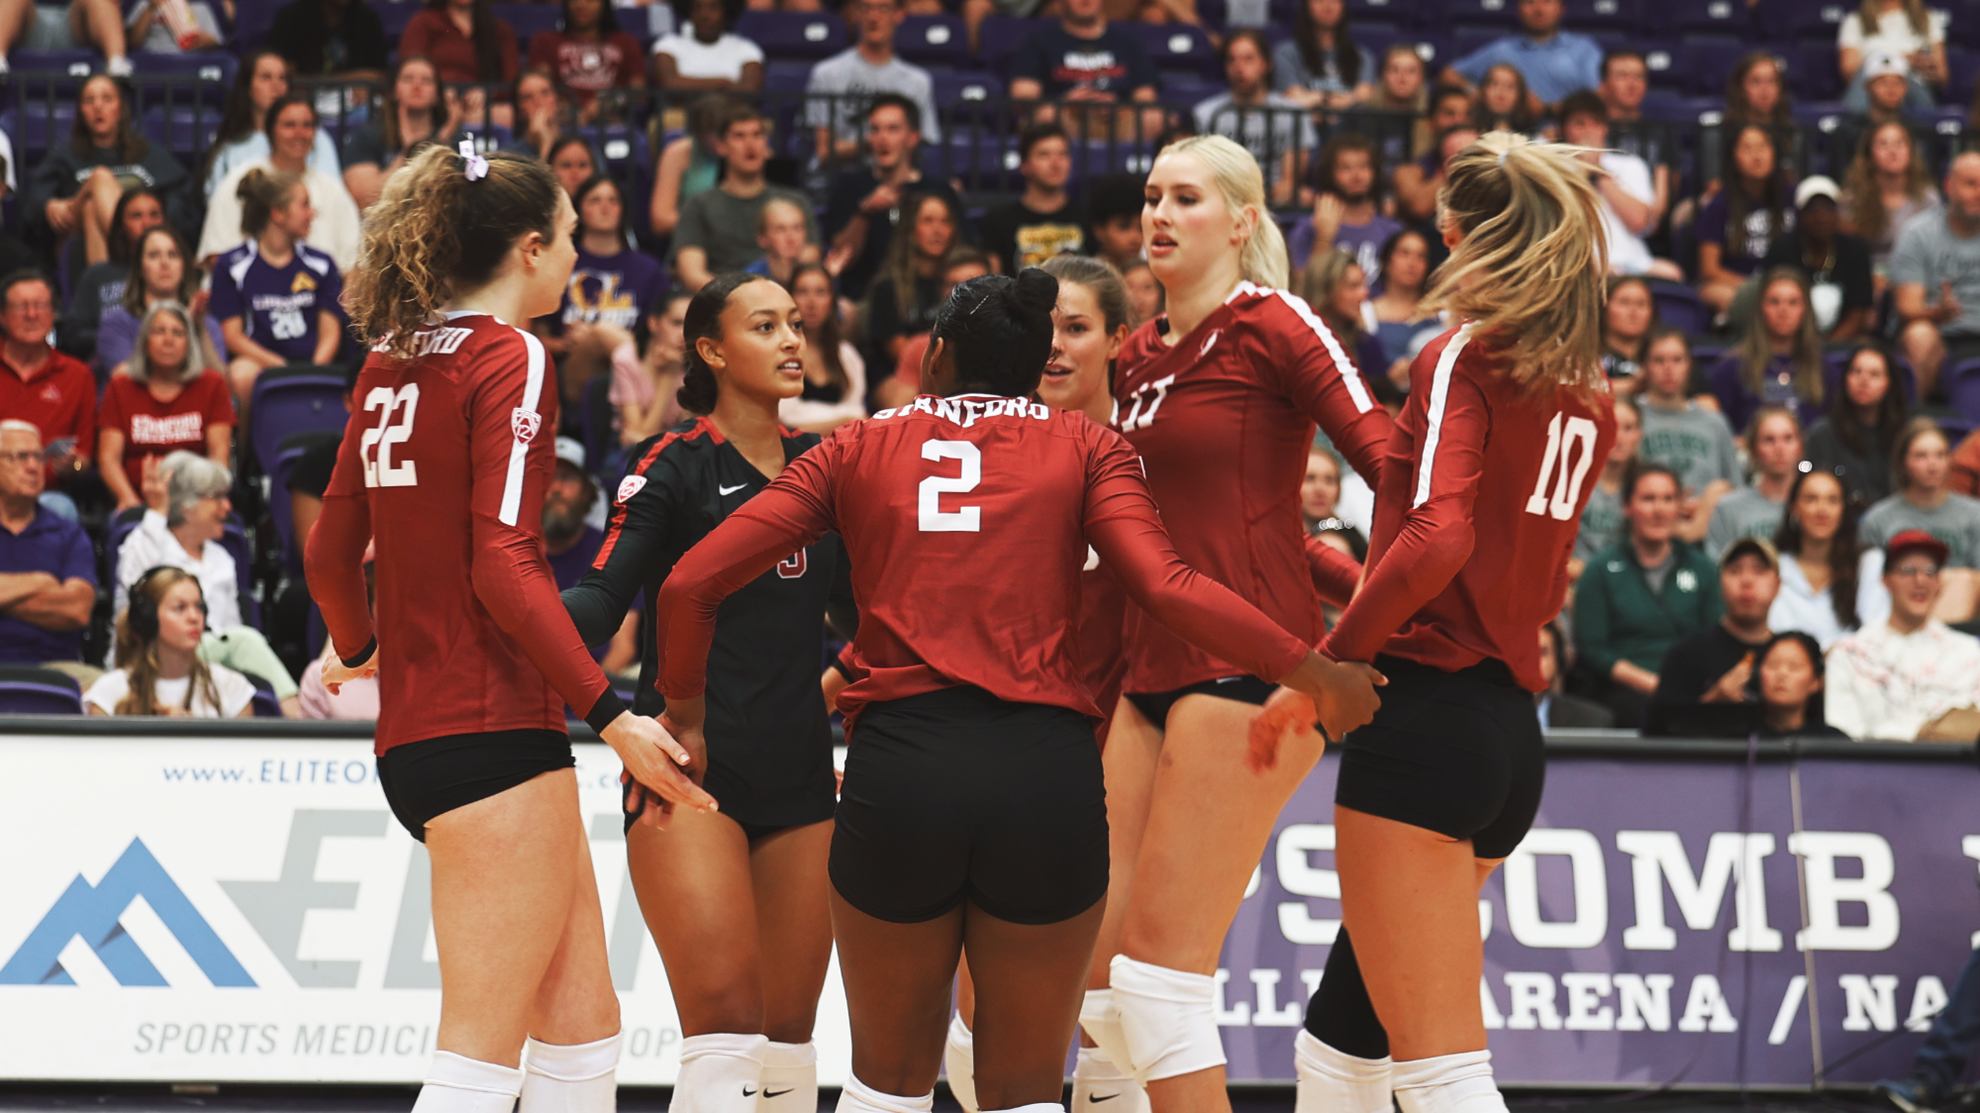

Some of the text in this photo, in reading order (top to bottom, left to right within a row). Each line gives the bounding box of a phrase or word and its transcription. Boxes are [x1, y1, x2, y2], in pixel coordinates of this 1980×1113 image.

[360, 382, 420, 488] 22
[872, 395, 1050, 428] STANFORD
[918, 438, 982, 532] 2
[1524, 410, 1598, 521] 10
[162, 760, 380, 784] www.ELITEO
[134, 1022, 432, 1056] SPORTS MEDICI
